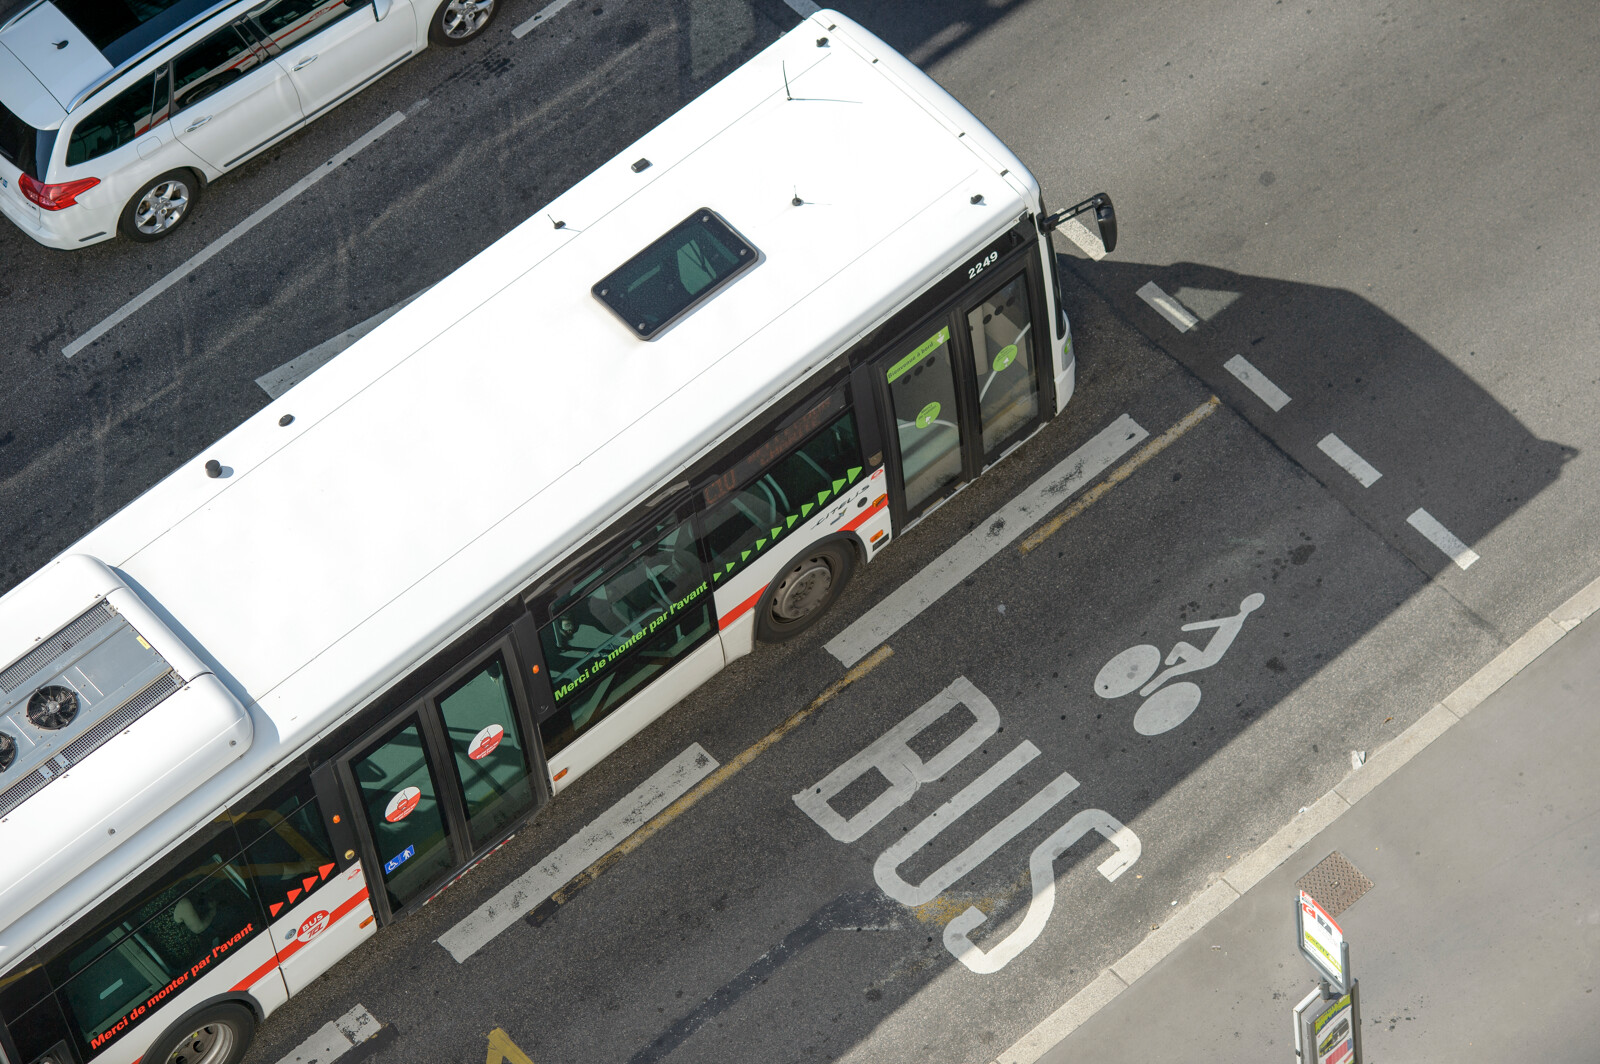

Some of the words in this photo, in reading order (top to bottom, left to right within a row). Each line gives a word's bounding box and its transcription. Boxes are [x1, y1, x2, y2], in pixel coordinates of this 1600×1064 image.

[968, 251, 998, 279] 2249
[888, 356, 916, 378] Bienvenue
[921, 341, 934, 354] bord
[554, 668, 590, 701] Merci
[591, 658, 607, 674] de
[608, 628, 648, 662] monter
[649, 611, 668, 633] par
[669, 581, 708, 615] l'avant
[792, 675, 1142, 974] BUS
[302, 912, 324, 932] BUS
[90, 1016, 129, 1050] Merci
[130, 1004, 146, 1021] de
[147, 971, 189, 1008] monter
[190, 954, 211, 977] par
[212, 923, 254, 958] l'avant
